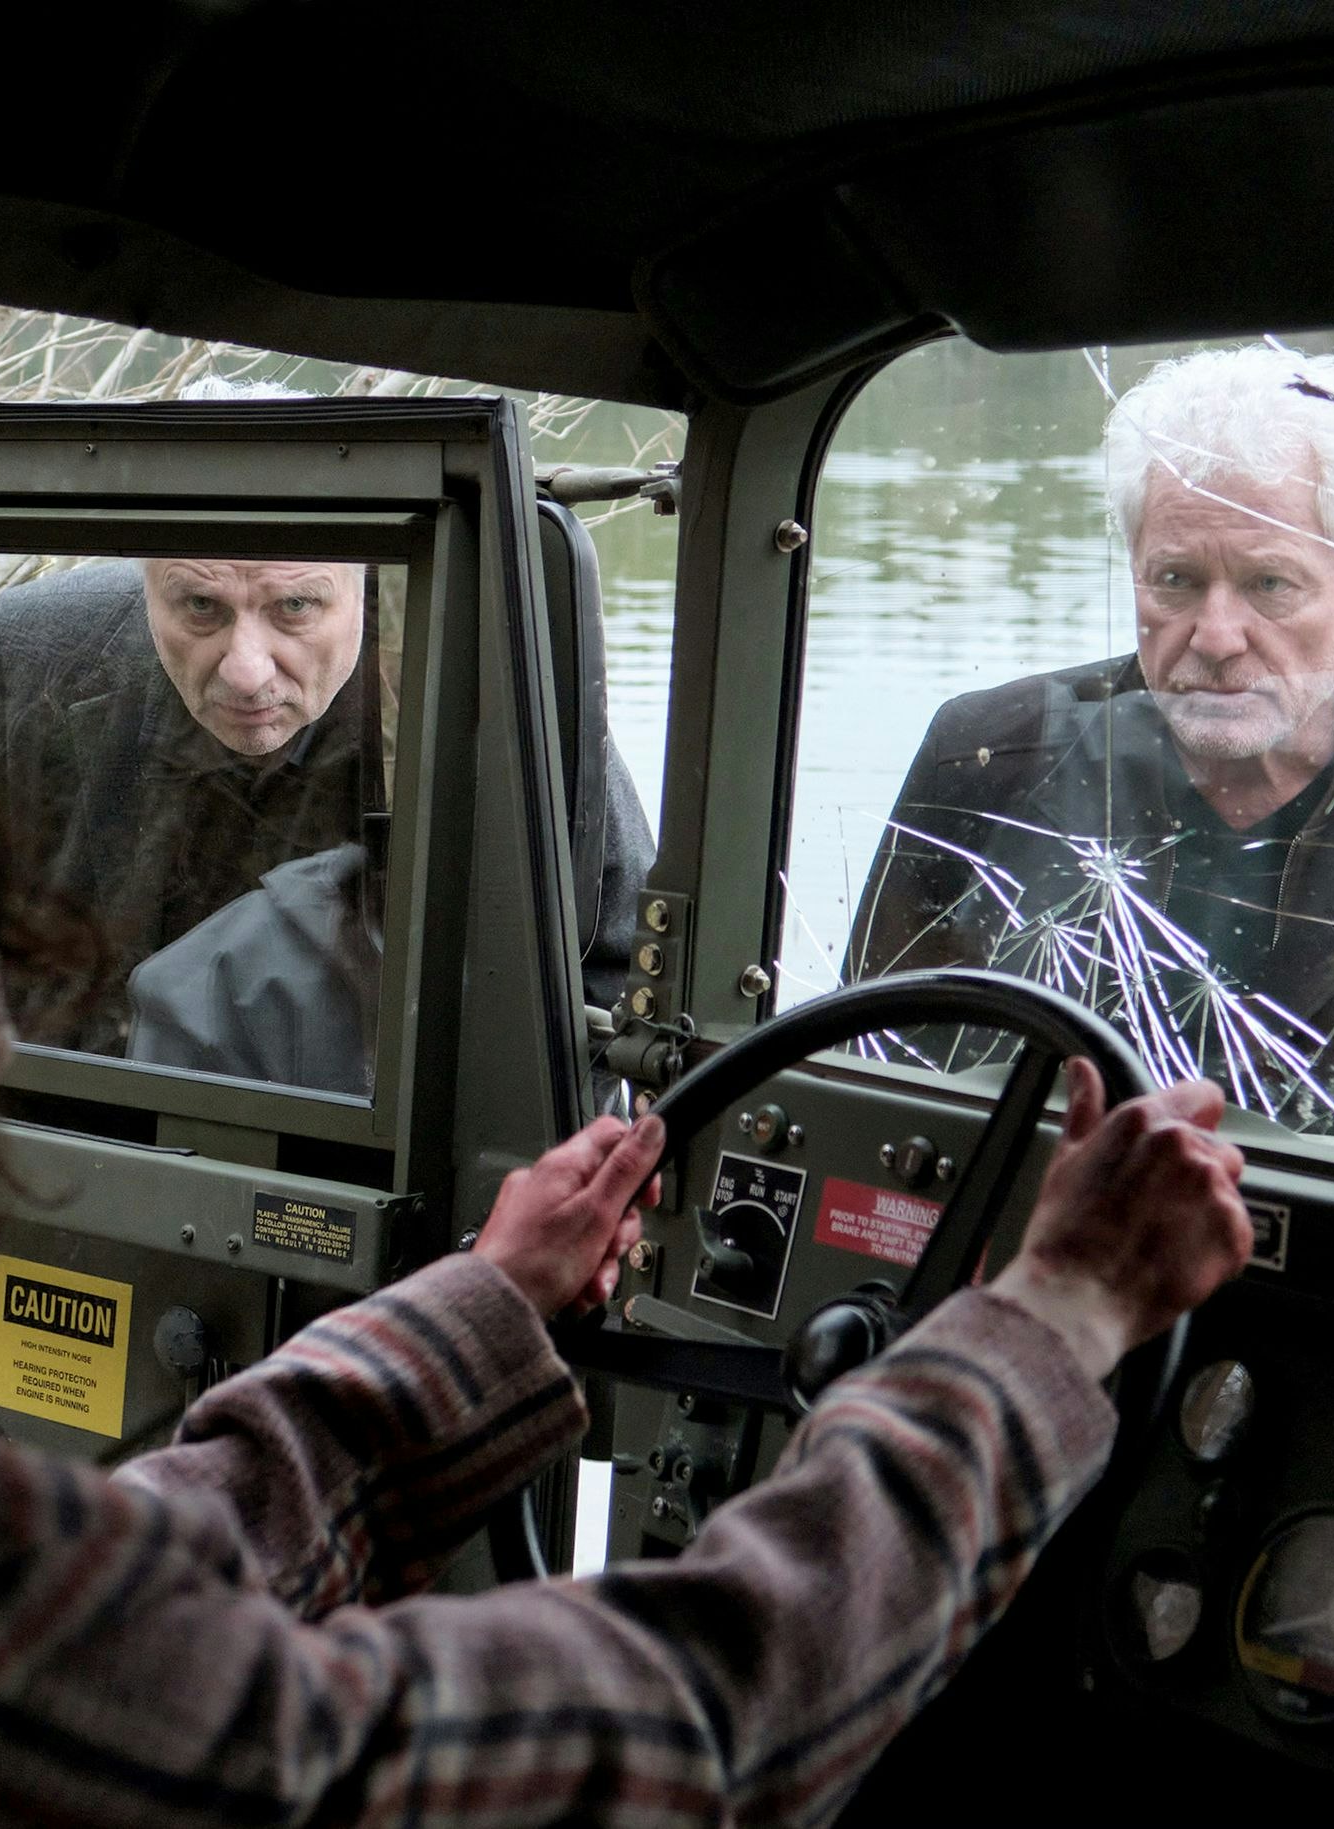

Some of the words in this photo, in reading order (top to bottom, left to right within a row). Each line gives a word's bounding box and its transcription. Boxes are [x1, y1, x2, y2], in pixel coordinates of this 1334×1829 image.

[719, 1175, 735, 1190] ENG
[749, 1182, 766, 1198] RUN
[716, 1188, 734, 1202] STOP
[773, 1188, 797, 1206] START
[285, 1202, 325, 1219] CAUTION
[830, 1208, 856, 1224] PRIOR
[857, 1215, 869, 1226] TO
[876, 1194, 940, 1226] WARNING
[256, 1217, 264, 1225] TO
[265, 1218, 286, 1230] FOLLOW
[287, 1223, 314, 1235] CLEANING
[314, 1228, 351, 1242] PROCEDURES
[257, 1209, 279, 1220] PLASTIC
[329, 1224, 351, 1234] FAILURE
[831, 1222, 860, 1237] BRAKE
[860, 1229, 879, 1242] AND
[255, 1225, 287, 1237] CONTAINED
[301, 1234, 309, 1242] TM
[255, 1232, 271, 1242] WILL
[275, 1237, 302, 1248] RESULT
[317, 1246, 347, 1258] DAMAGE
[871, 1243, 883, 1255] TO
[883, 1246, 919, 1265] NEUTRA
[10, 1285, 111, 1338] CAUTION
[21, 1340, 37, 1350] HIGH
[39, 1345, 70, 1358] INTENSITY
[72, 1352, 92, 1364] NOISE
[13, 1359, 46, 1375] HEARING
[48, 1368, 97, 1388] PROTECTION
[22, 1375, 61, 1392] REQUIRED
[63, 1385, 86, 1398] WHEN
[16, 1386, 44, 1401] ENGINE
[46, 1394, 53, 1404] IS
[55, 1396, 90, 1413] RUNNING
